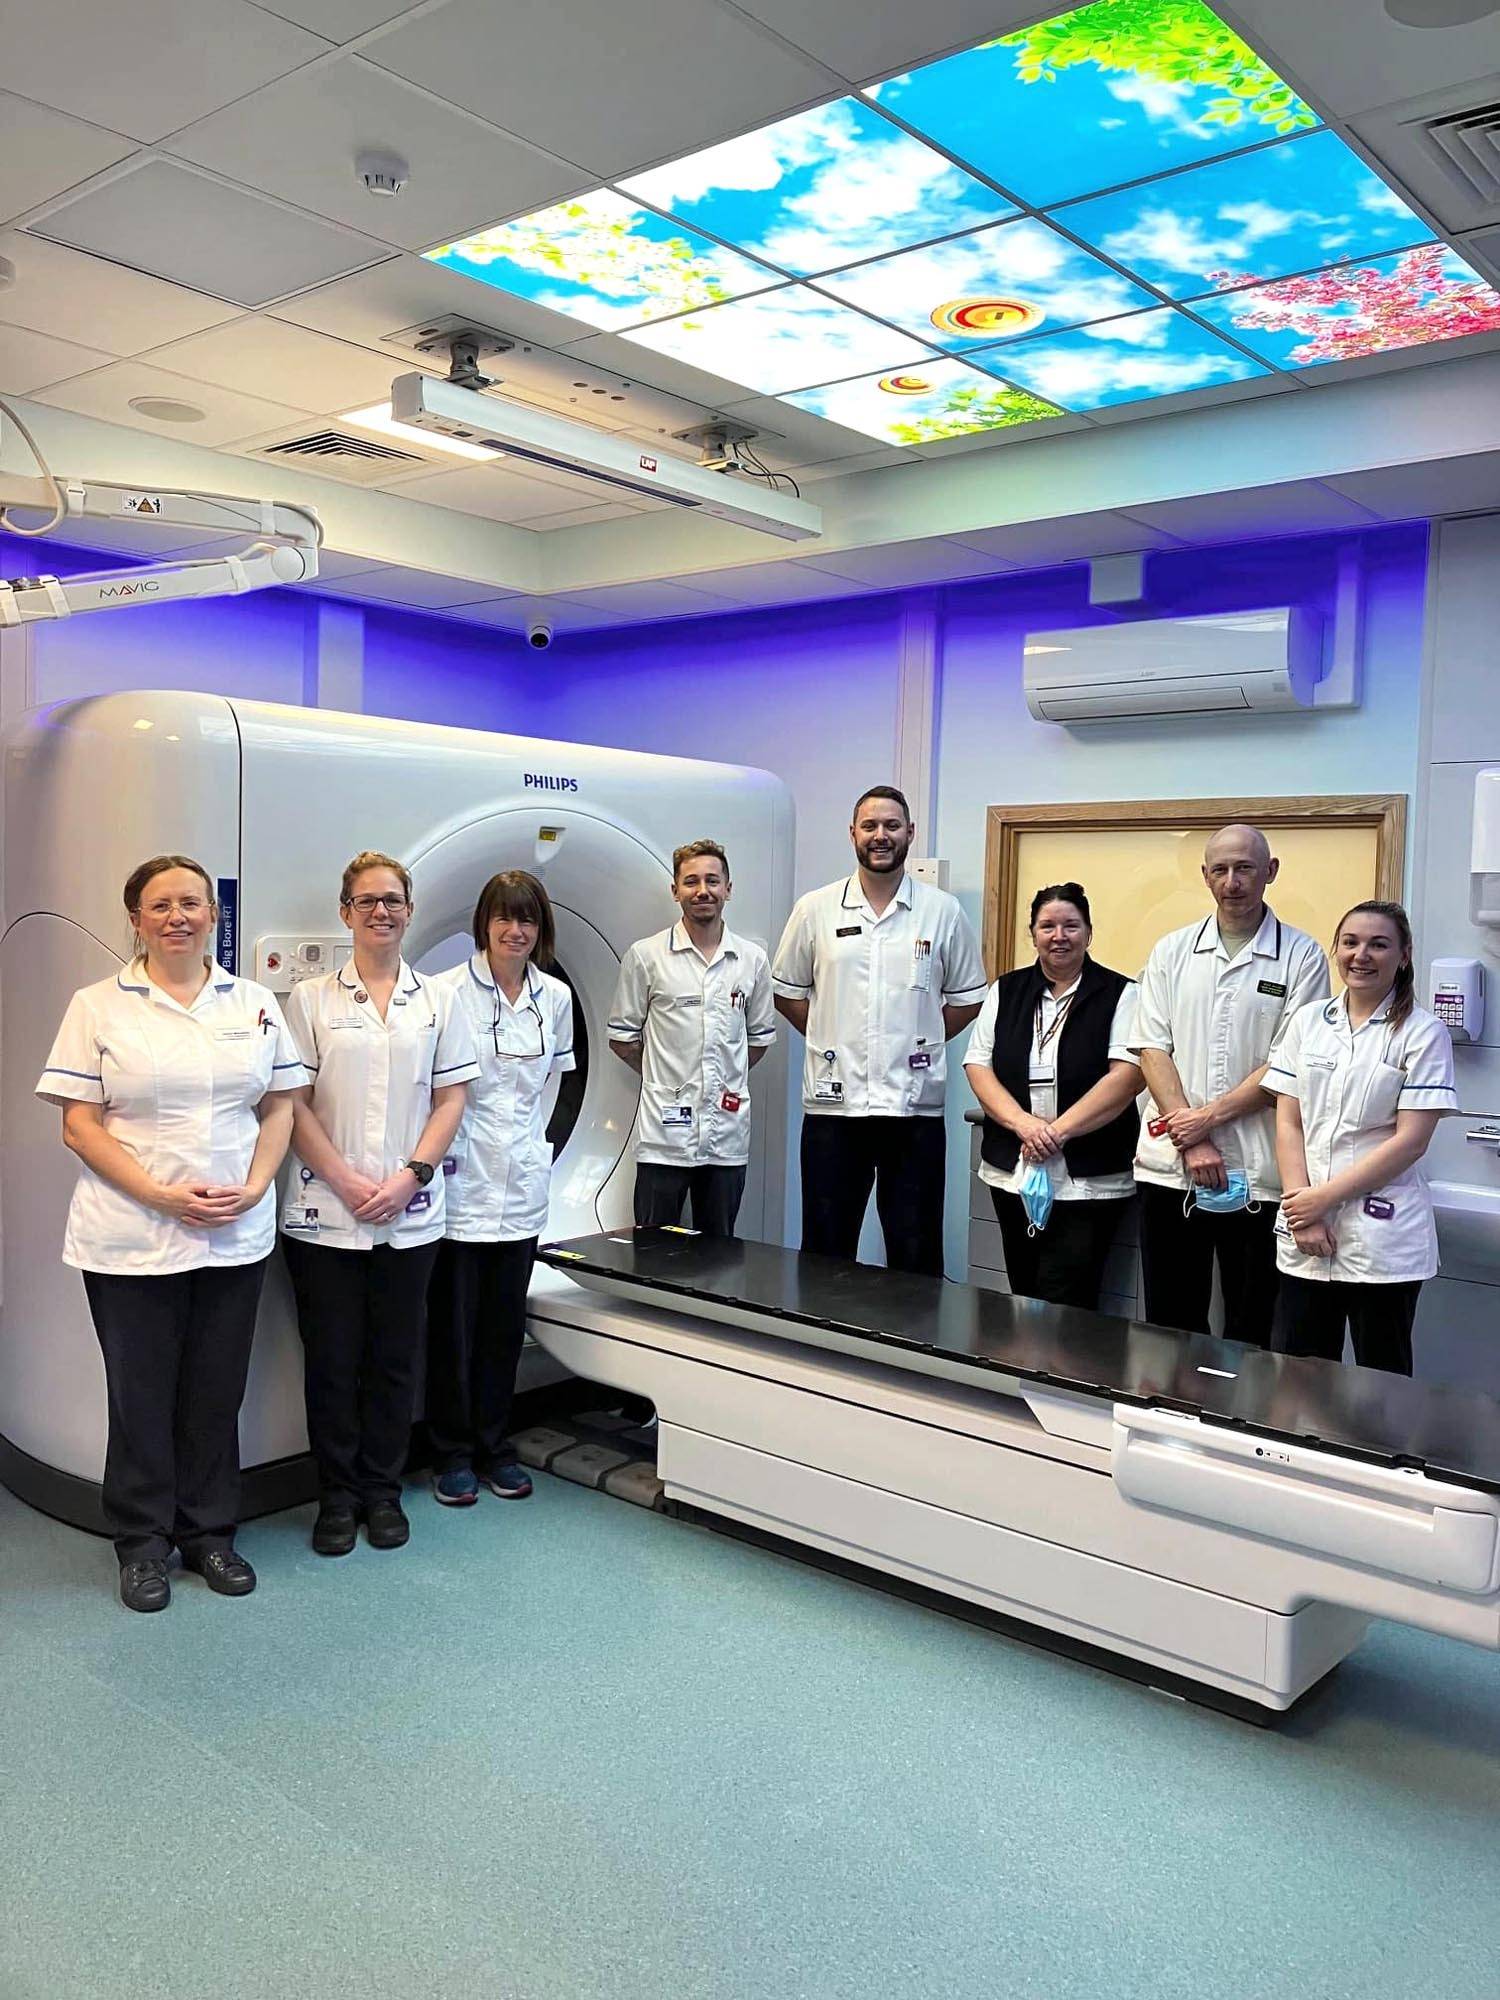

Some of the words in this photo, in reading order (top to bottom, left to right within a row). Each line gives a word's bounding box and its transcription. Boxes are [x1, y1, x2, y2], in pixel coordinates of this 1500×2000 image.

[99, 580, 159, 598] MAVIG
[523, 773, 578, 792] PHILIPS
[223, 904, 232, 919] RT
[223, 920, 232, 947] Bore
[222, 949, 234, 968] Big
